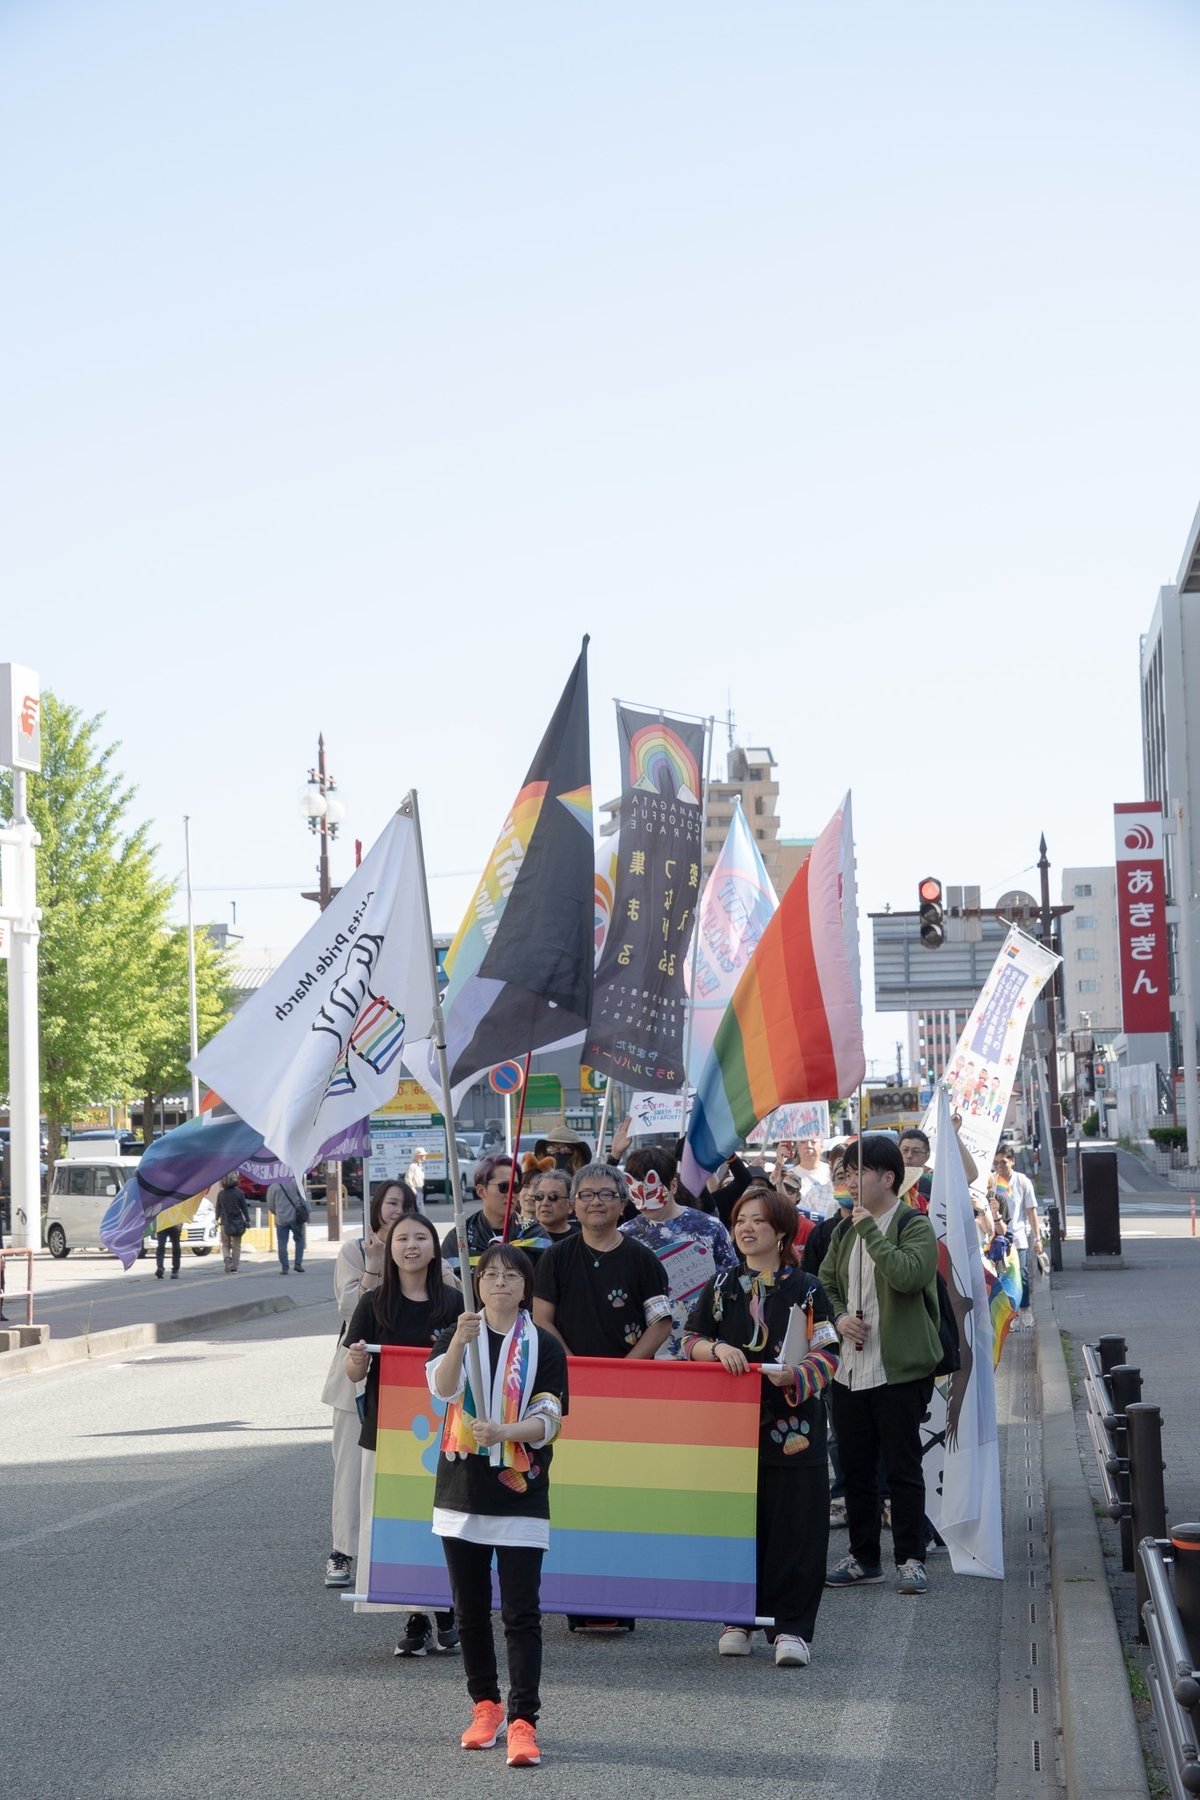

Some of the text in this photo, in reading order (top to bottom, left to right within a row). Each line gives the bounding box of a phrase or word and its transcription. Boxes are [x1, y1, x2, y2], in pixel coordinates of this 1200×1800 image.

[1127, 869, 1158, 994] あきぎん
[594, 1070, 607, 1088] P
